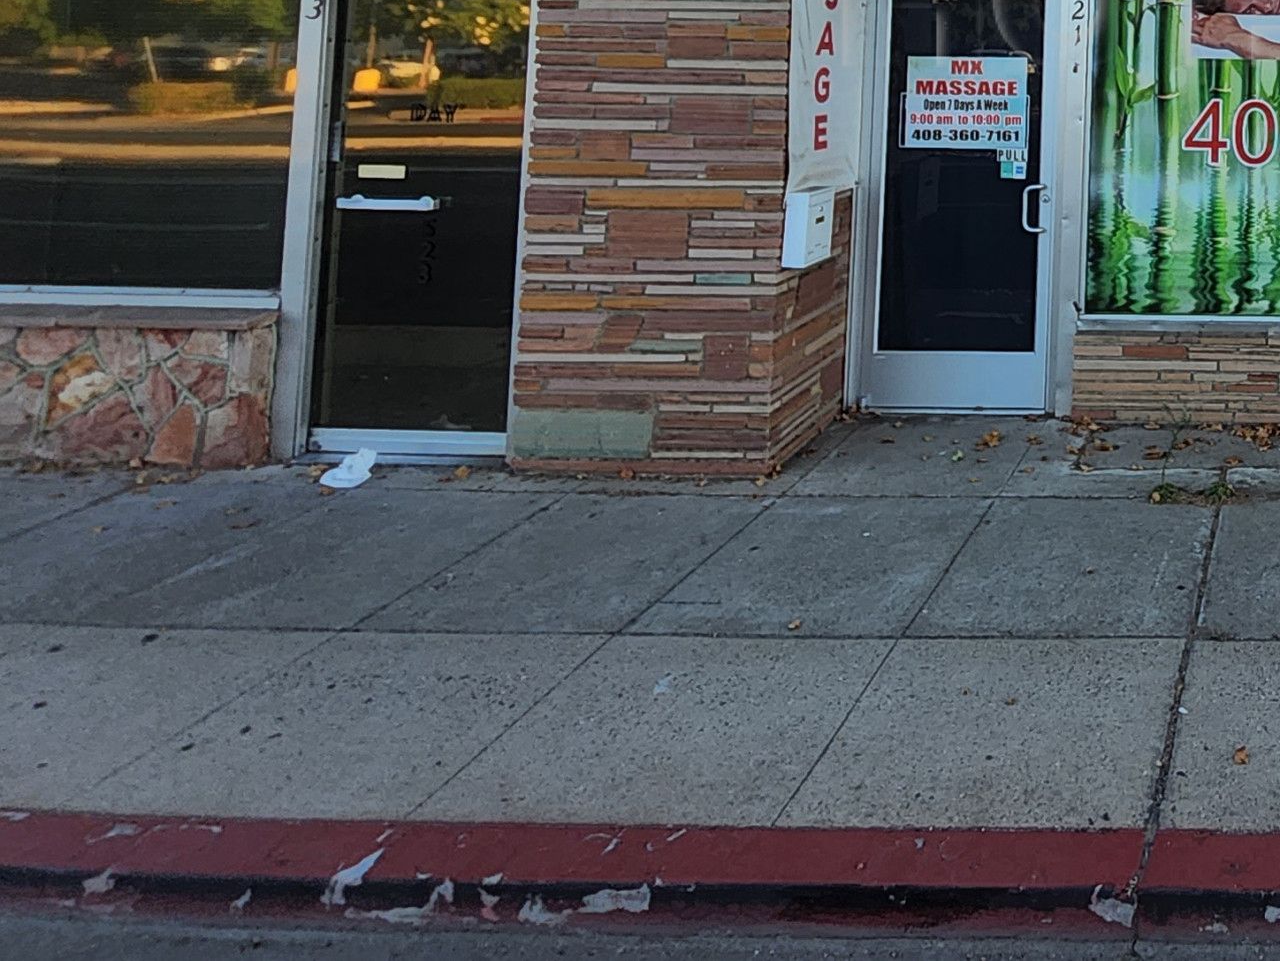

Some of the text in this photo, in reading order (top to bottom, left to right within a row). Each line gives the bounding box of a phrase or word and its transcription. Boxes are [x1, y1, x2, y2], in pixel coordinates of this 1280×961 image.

[914, 80, 1019, 97] MASSAGE
[923, 98, 1009, 112] Open 7 Days A Week
[910, 113, 1022, 127] 9:00 am to 10:00 pm
[911, 129, 1020, 142] 408-360-7161
[998, 149, 1027, 162] PULL
